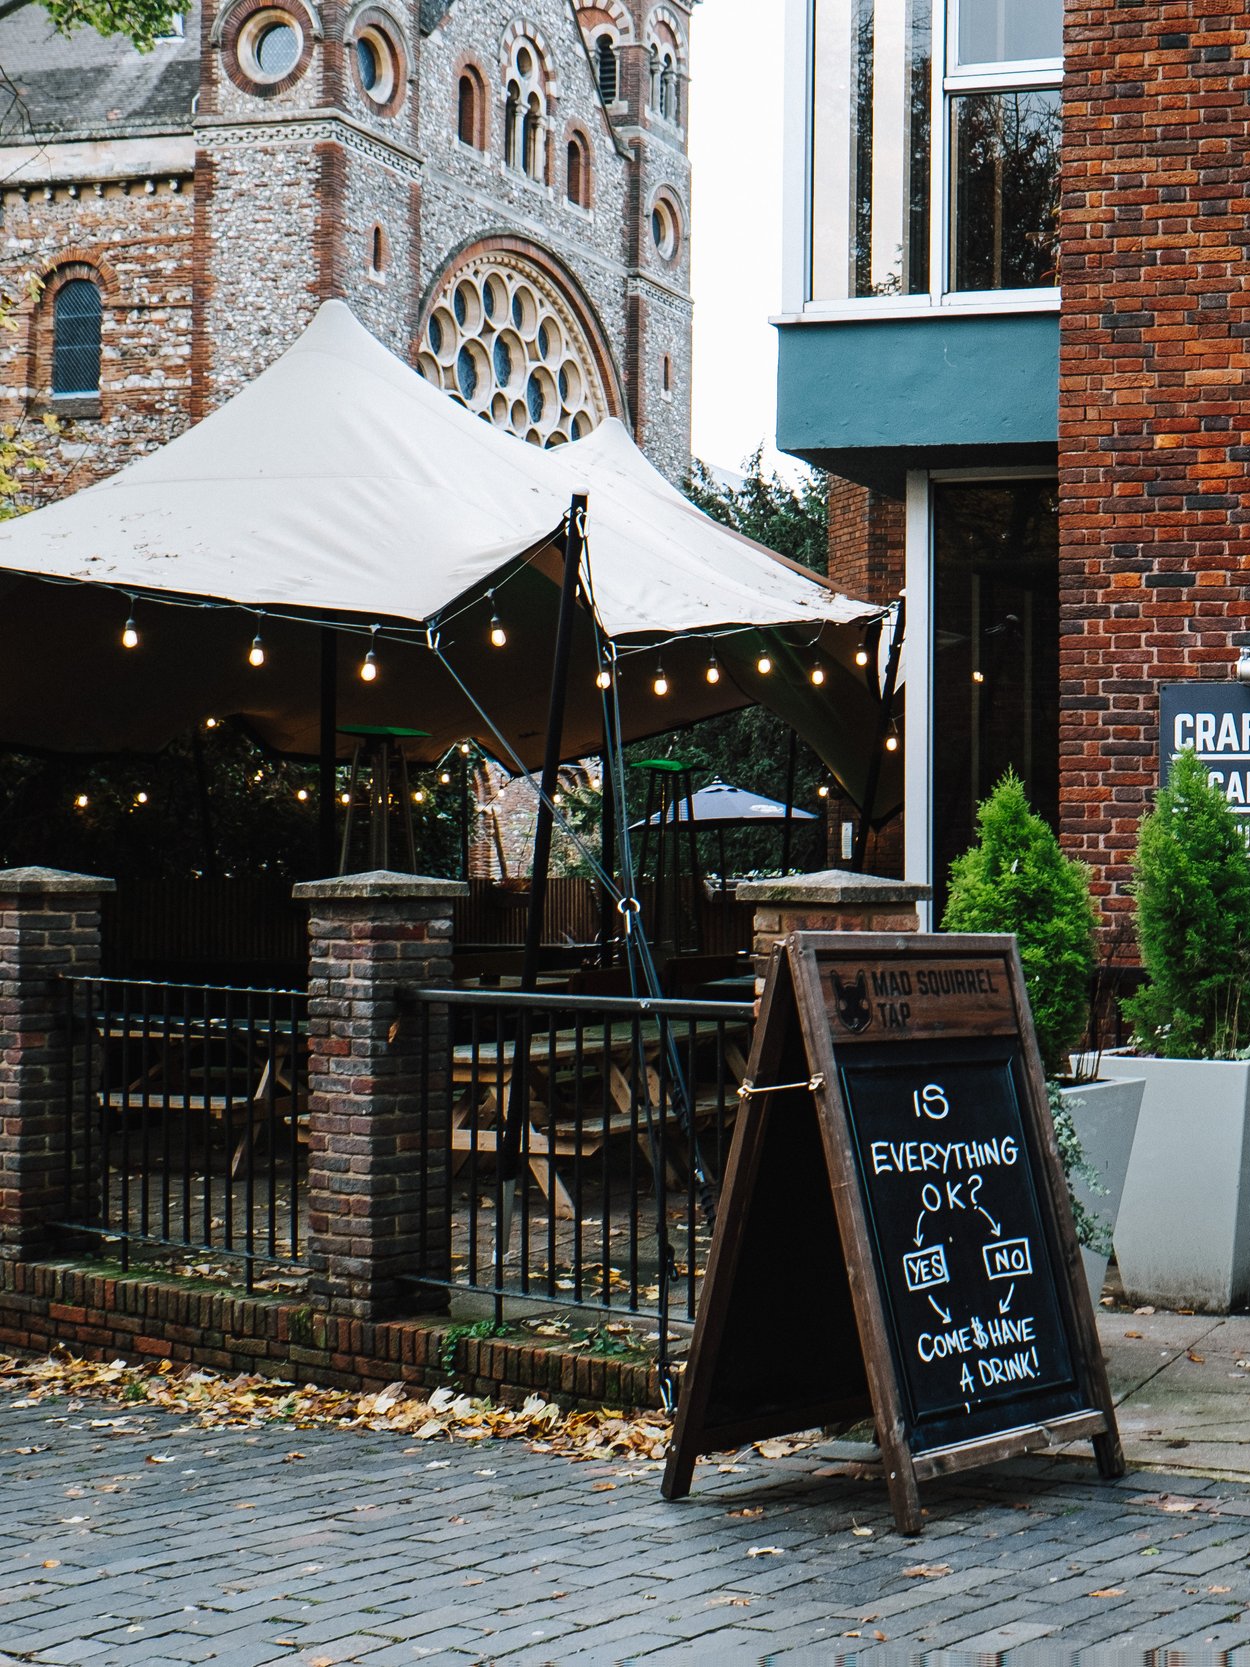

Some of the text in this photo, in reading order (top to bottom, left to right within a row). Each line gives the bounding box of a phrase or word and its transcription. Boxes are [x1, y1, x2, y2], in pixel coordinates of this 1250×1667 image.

[871, 968, 1000, 998] MAD SQUIRREL
[876, 1003, 912, 1030] TAP
[912, 1083, 950, 1120] IS
[870, 1136, 1019, 1176] EVERYTHING
[922, 1174, 983, 1212] OK?
[907, 1254, 944, 1284] YES
[995, 1247, 1025, 1273] NO
[917, 1327, 973, 1363] COME
[988, 1316, 1037, 1353] HAVE
[960, 1345, 1042, 1394] A DRINK!
